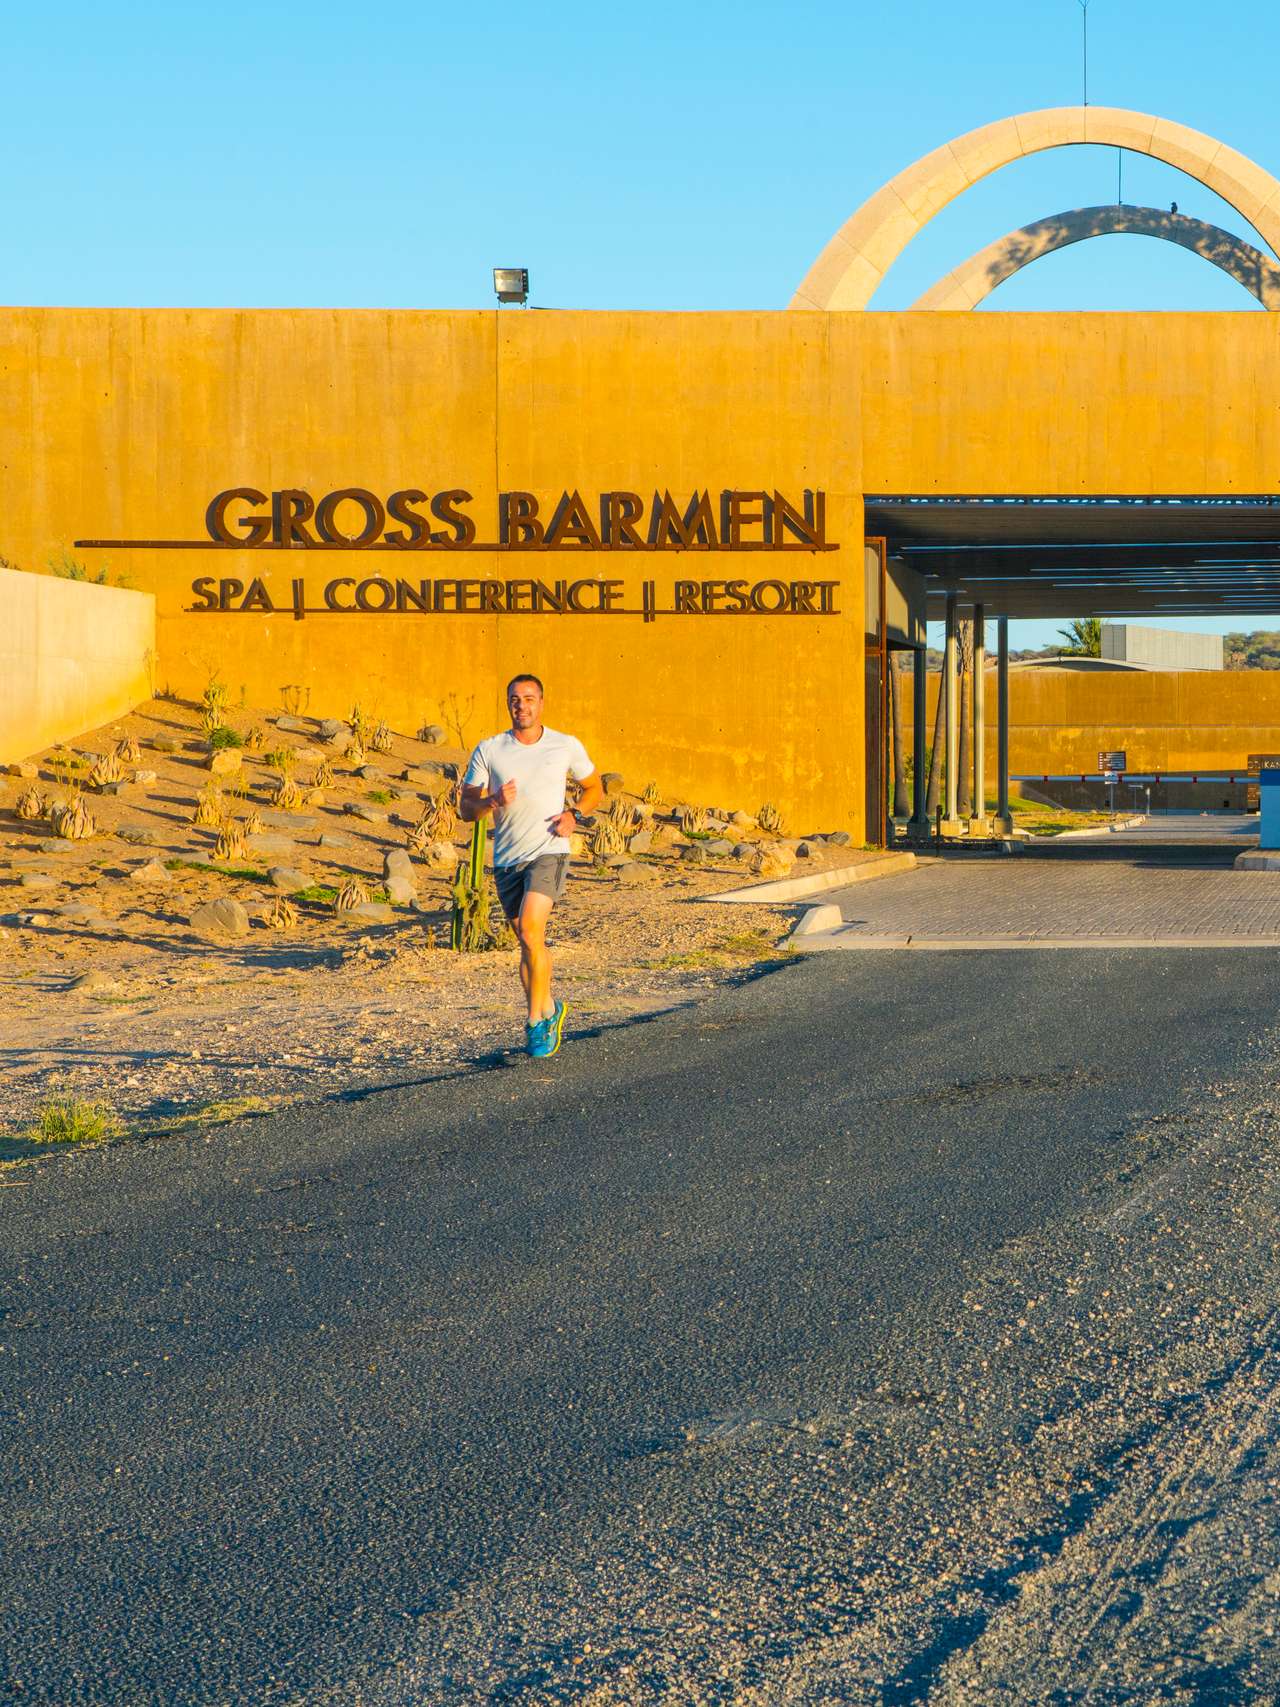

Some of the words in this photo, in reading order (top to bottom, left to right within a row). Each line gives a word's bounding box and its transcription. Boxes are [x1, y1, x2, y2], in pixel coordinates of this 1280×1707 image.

[208, 487, 476, 549] GROSS
[501, 487, 826, 551] BARMEN
[191, 576, 274, 610] SPA
[324, 578, 625, 611] CONFERENCE
[675, 579, 841, 612] RESORT
